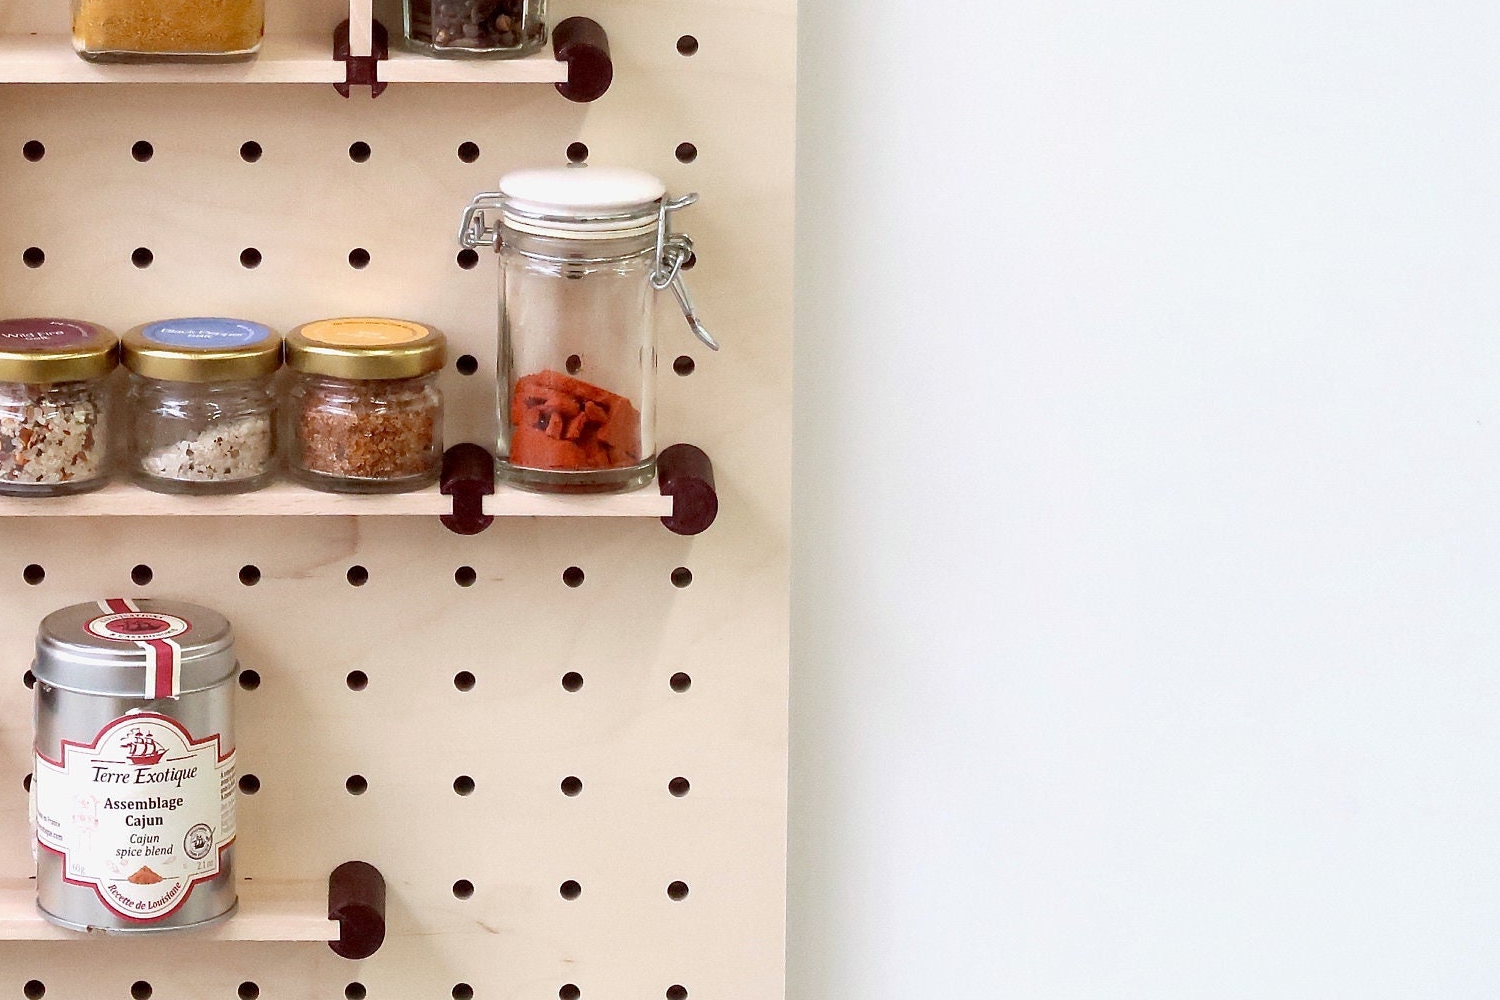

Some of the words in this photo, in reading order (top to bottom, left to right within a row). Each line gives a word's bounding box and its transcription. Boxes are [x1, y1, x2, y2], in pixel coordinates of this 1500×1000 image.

[91, 766, 130, 784] Terre
[133, 766, 198, 788] Exotique
[104, 797, 184, 811] Assemblage
[125, 815, 164, 829] Cajun
[129, 833, 160, 847] Cajun
[116, 847, 142, 859] spice
[144, 844, 174, 857] blend
[107, 884, 135, 908] Recette
[135, 901, 146, 910] de
[147, 882, 182, 910] Louisiane
